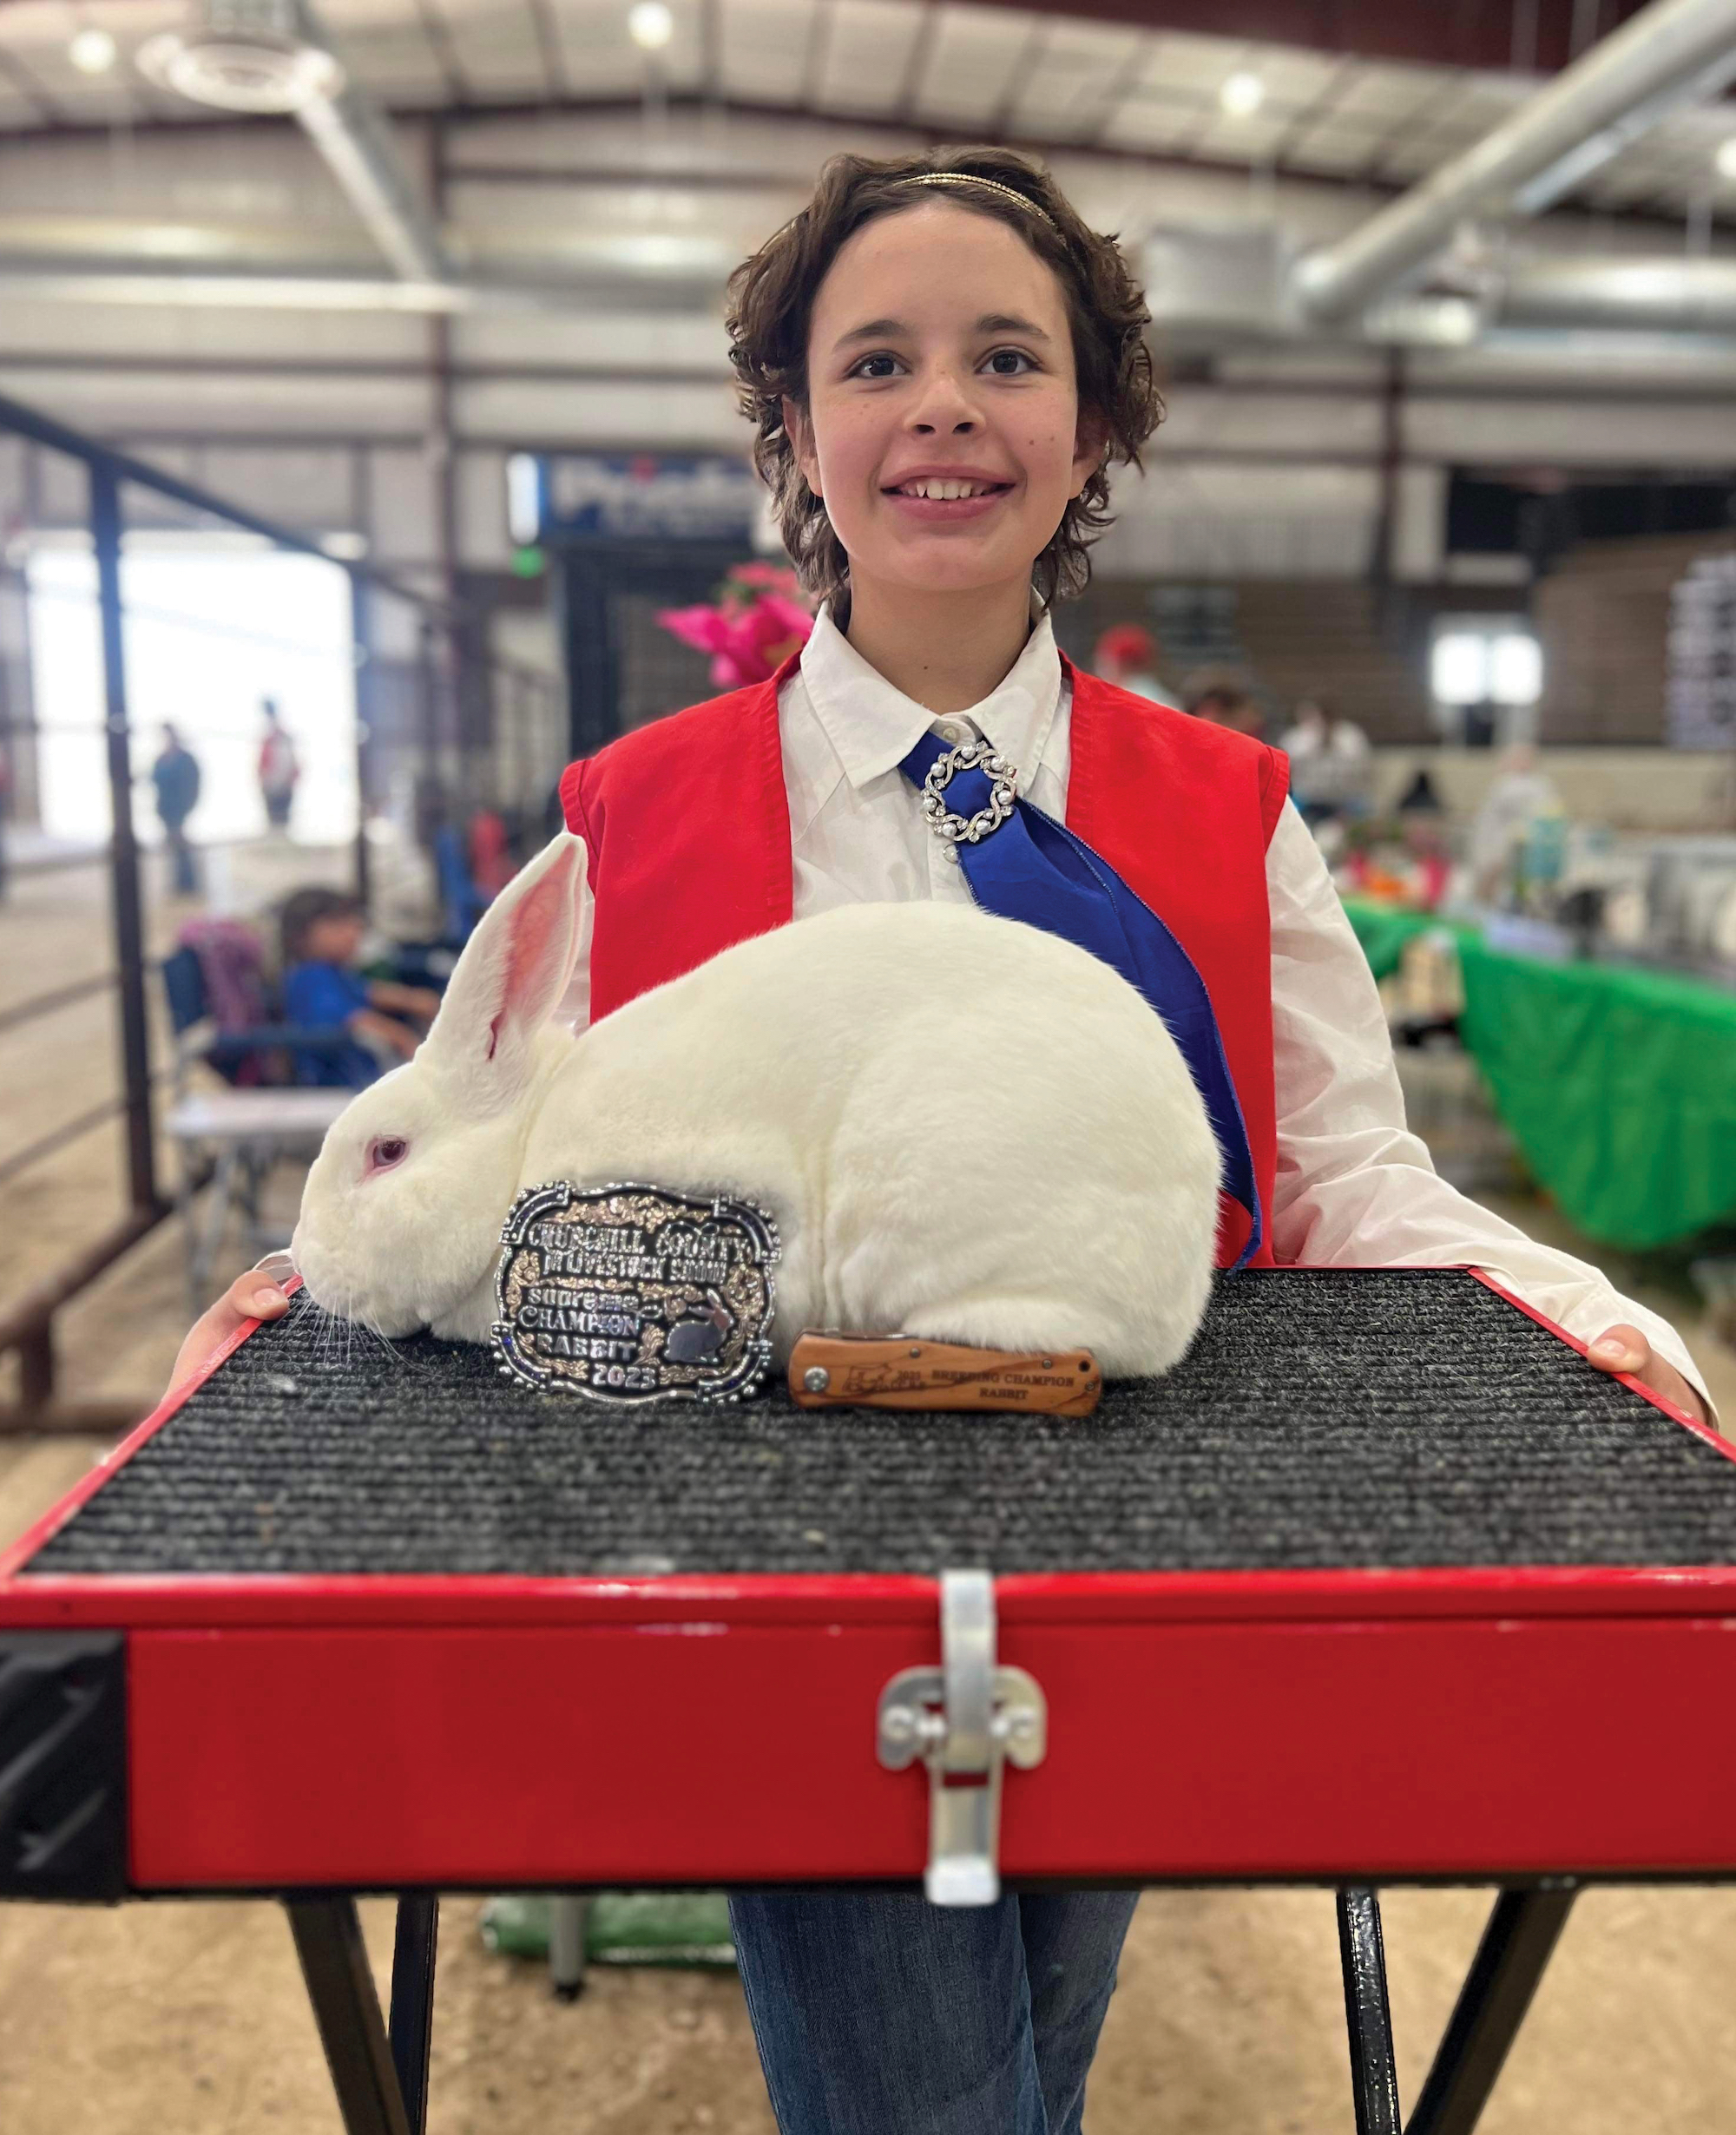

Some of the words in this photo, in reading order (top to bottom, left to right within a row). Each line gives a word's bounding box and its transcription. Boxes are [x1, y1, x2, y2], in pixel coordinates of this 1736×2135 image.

[655, 1223, 750, 1263] COUNTY
[536, 1332, 637, 1361] RABBIT
[592, 1363, 656, 1389] 2023
[931, 1370, 1000, 1384] BREEDING
[1003, 1373, 1075, 1388] CHAMPION
[979, 1387, 1029, 1400] RABBIT
